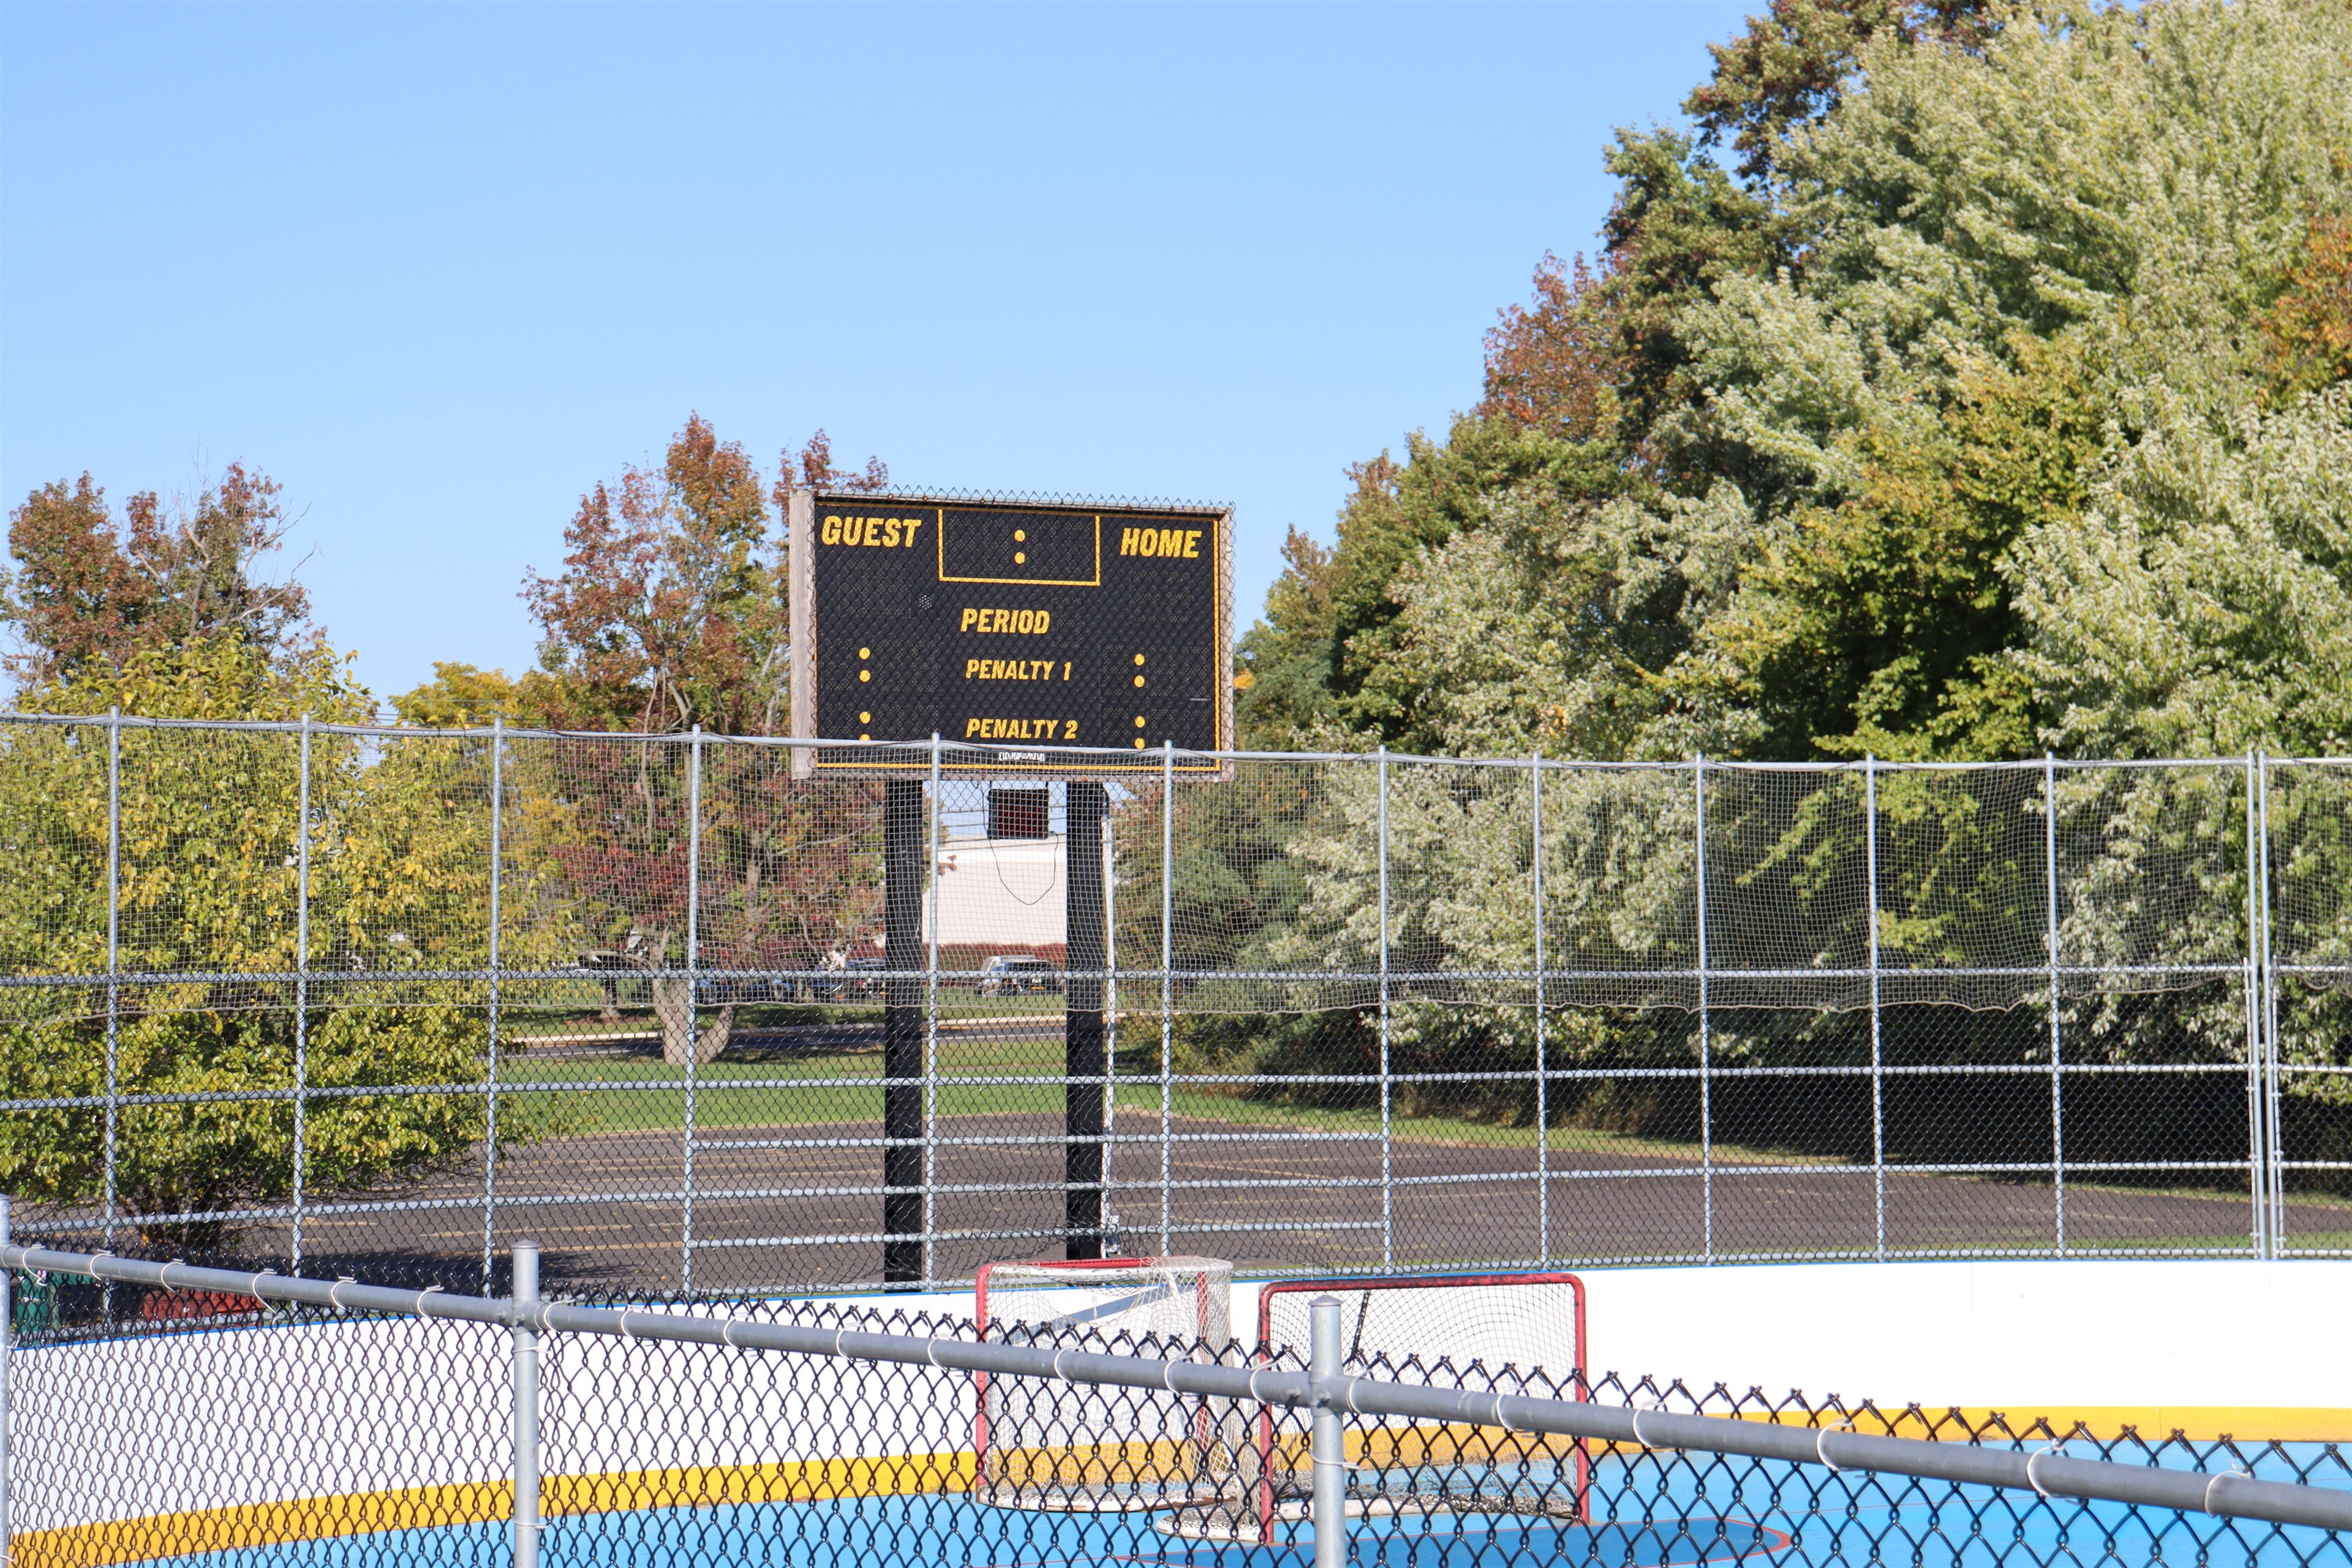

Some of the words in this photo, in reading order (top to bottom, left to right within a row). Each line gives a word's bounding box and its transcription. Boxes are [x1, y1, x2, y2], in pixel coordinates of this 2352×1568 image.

[821, 515, 922, 548] GUEST
[1120, 527, 1202, 558] HOME
[960, 608, 1050, 635] PERIOD
[965, 659, 1055, 680] PENALTY
[1063, 662, 1072, 681] 1
[965, 718, 1058, 739] PENALTY
[1063, 720, 1078, 739] 2
